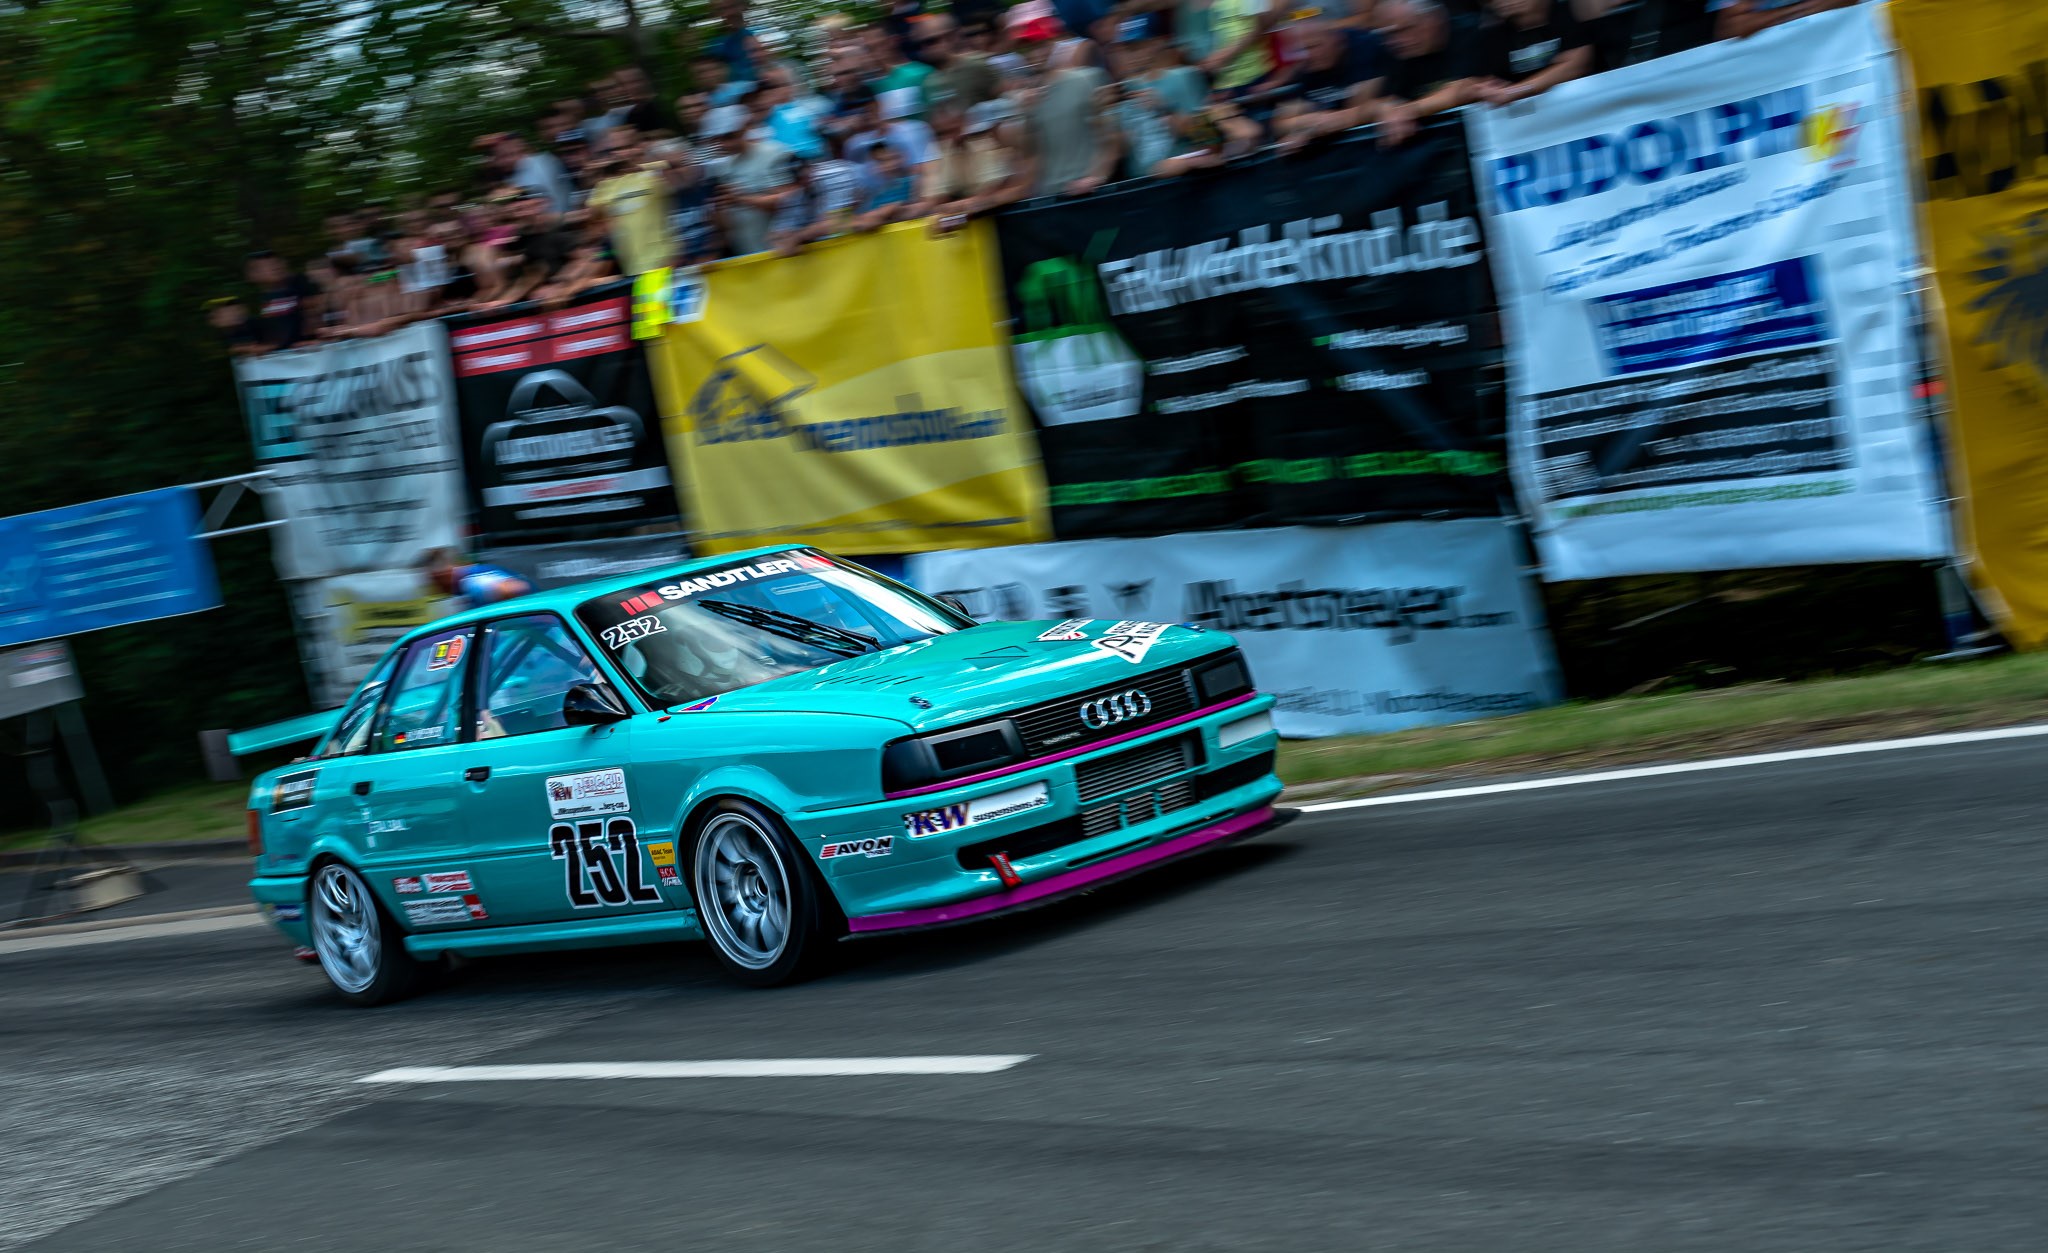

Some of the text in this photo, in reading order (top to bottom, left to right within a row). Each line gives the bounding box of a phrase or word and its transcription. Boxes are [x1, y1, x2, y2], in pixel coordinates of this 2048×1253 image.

[1488, 85, 1806, 215] RUDOLPH
[658, 559, 801, 600] SANDTLER
[600, 615, 667, 649] 252
[915, 803, 971, 836] KW
[548, 816, 663, 909] 252
[837, 837, 893, 855] AVON
